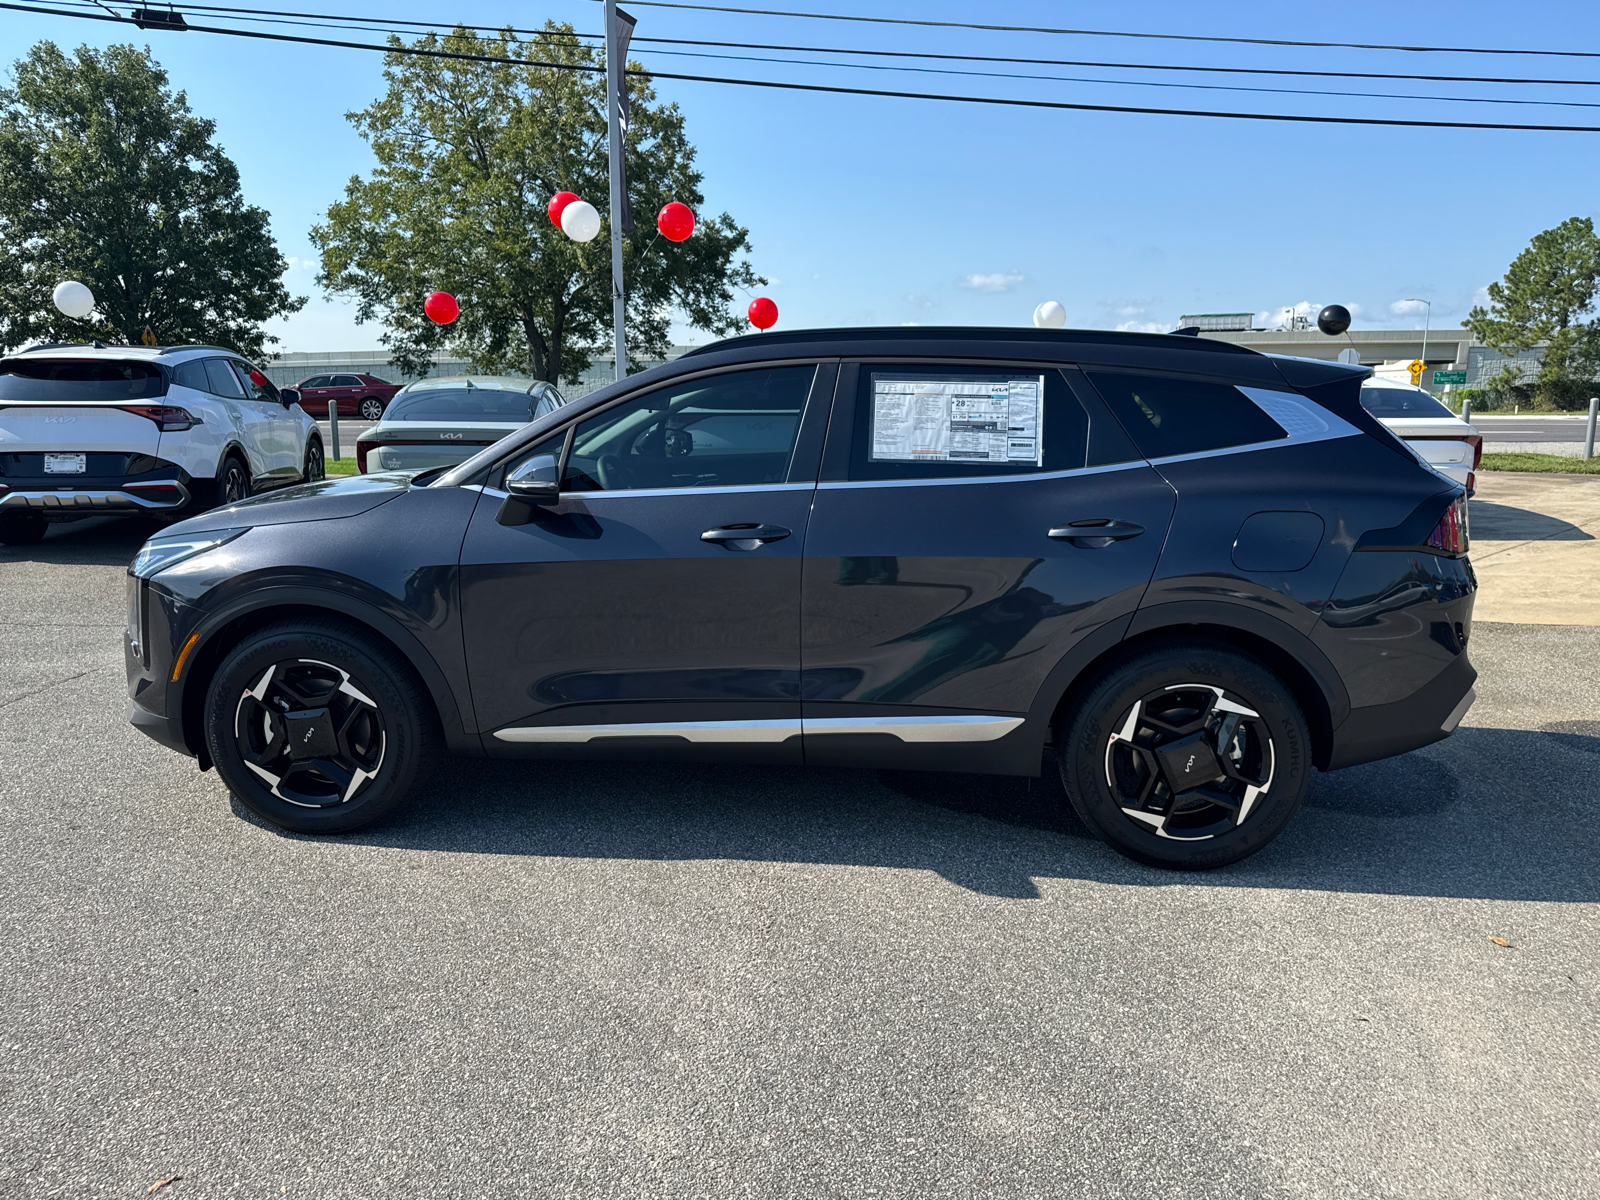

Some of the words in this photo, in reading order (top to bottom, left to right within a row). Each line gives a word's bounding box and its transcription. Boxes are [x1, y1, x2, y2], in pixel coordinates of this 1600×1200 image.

[45, 416, 76, 424] KIA
[236, 640, 289, 669] KUMHO
[303, 727, 315, 743] KIA
[1281, 717, 1300, 779] KUMHO
[1184, 754, 1196, 773] KIA
